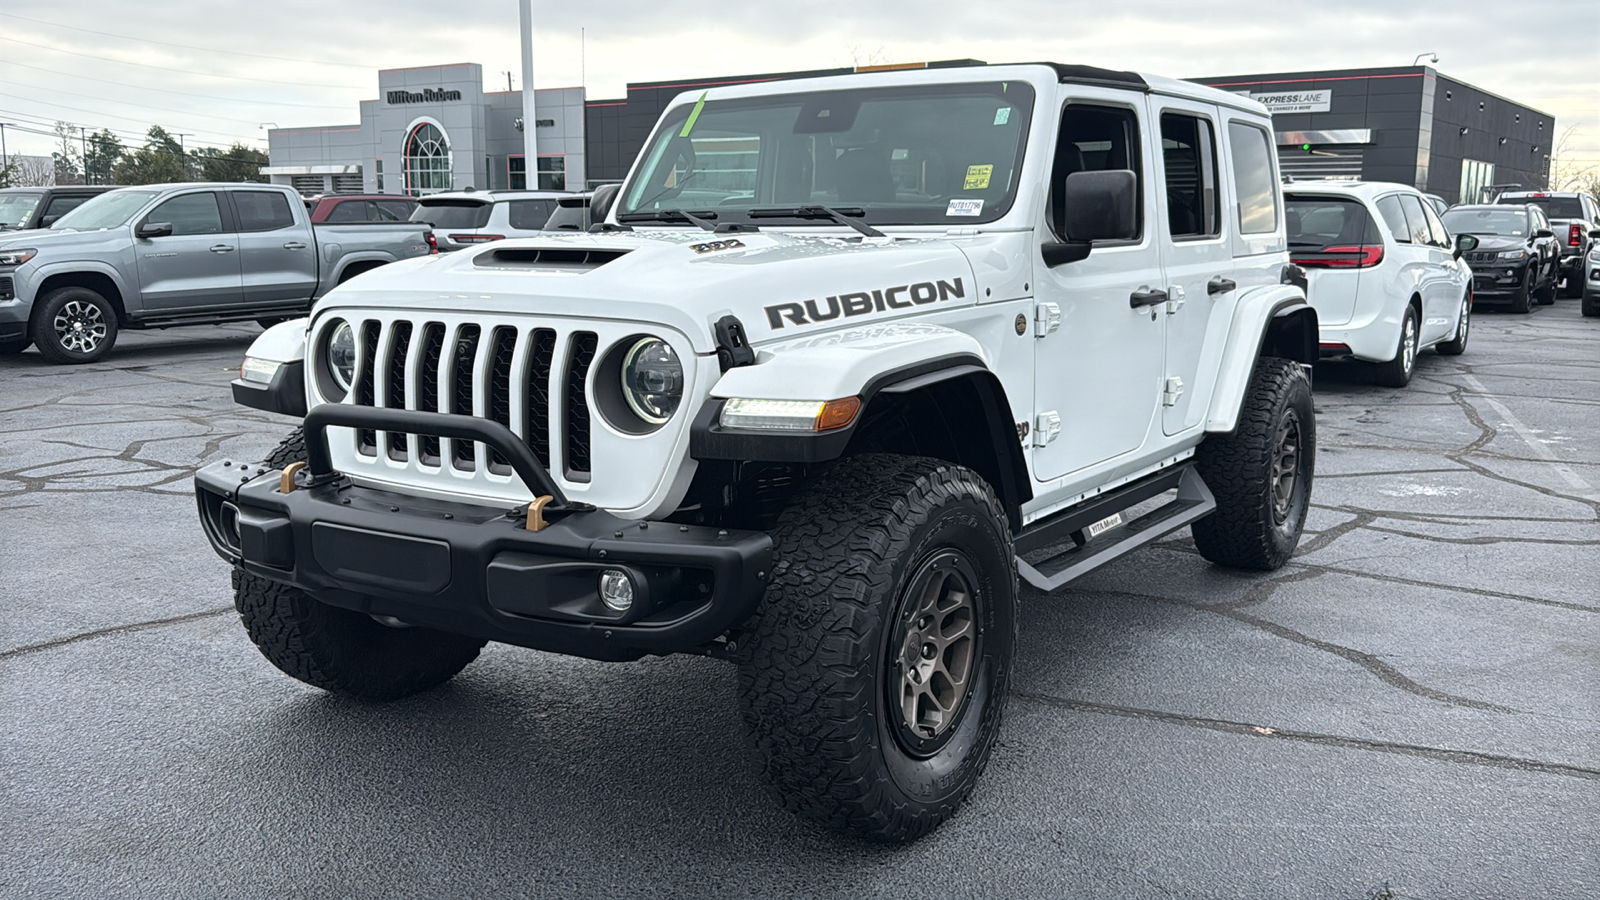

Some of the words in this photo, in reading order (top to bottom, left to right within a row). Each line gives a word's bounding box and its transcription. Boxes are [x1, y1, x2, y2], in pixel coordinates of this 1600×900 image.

[387, 90, 423, 105] Milton
[423, 87, 461, 102] Ruben
[1257, 93, 1322, 104] EXPRESSLANE
[763, 277, 966, 331] RUBICON
[1016, 420, 1030, 442] ep
